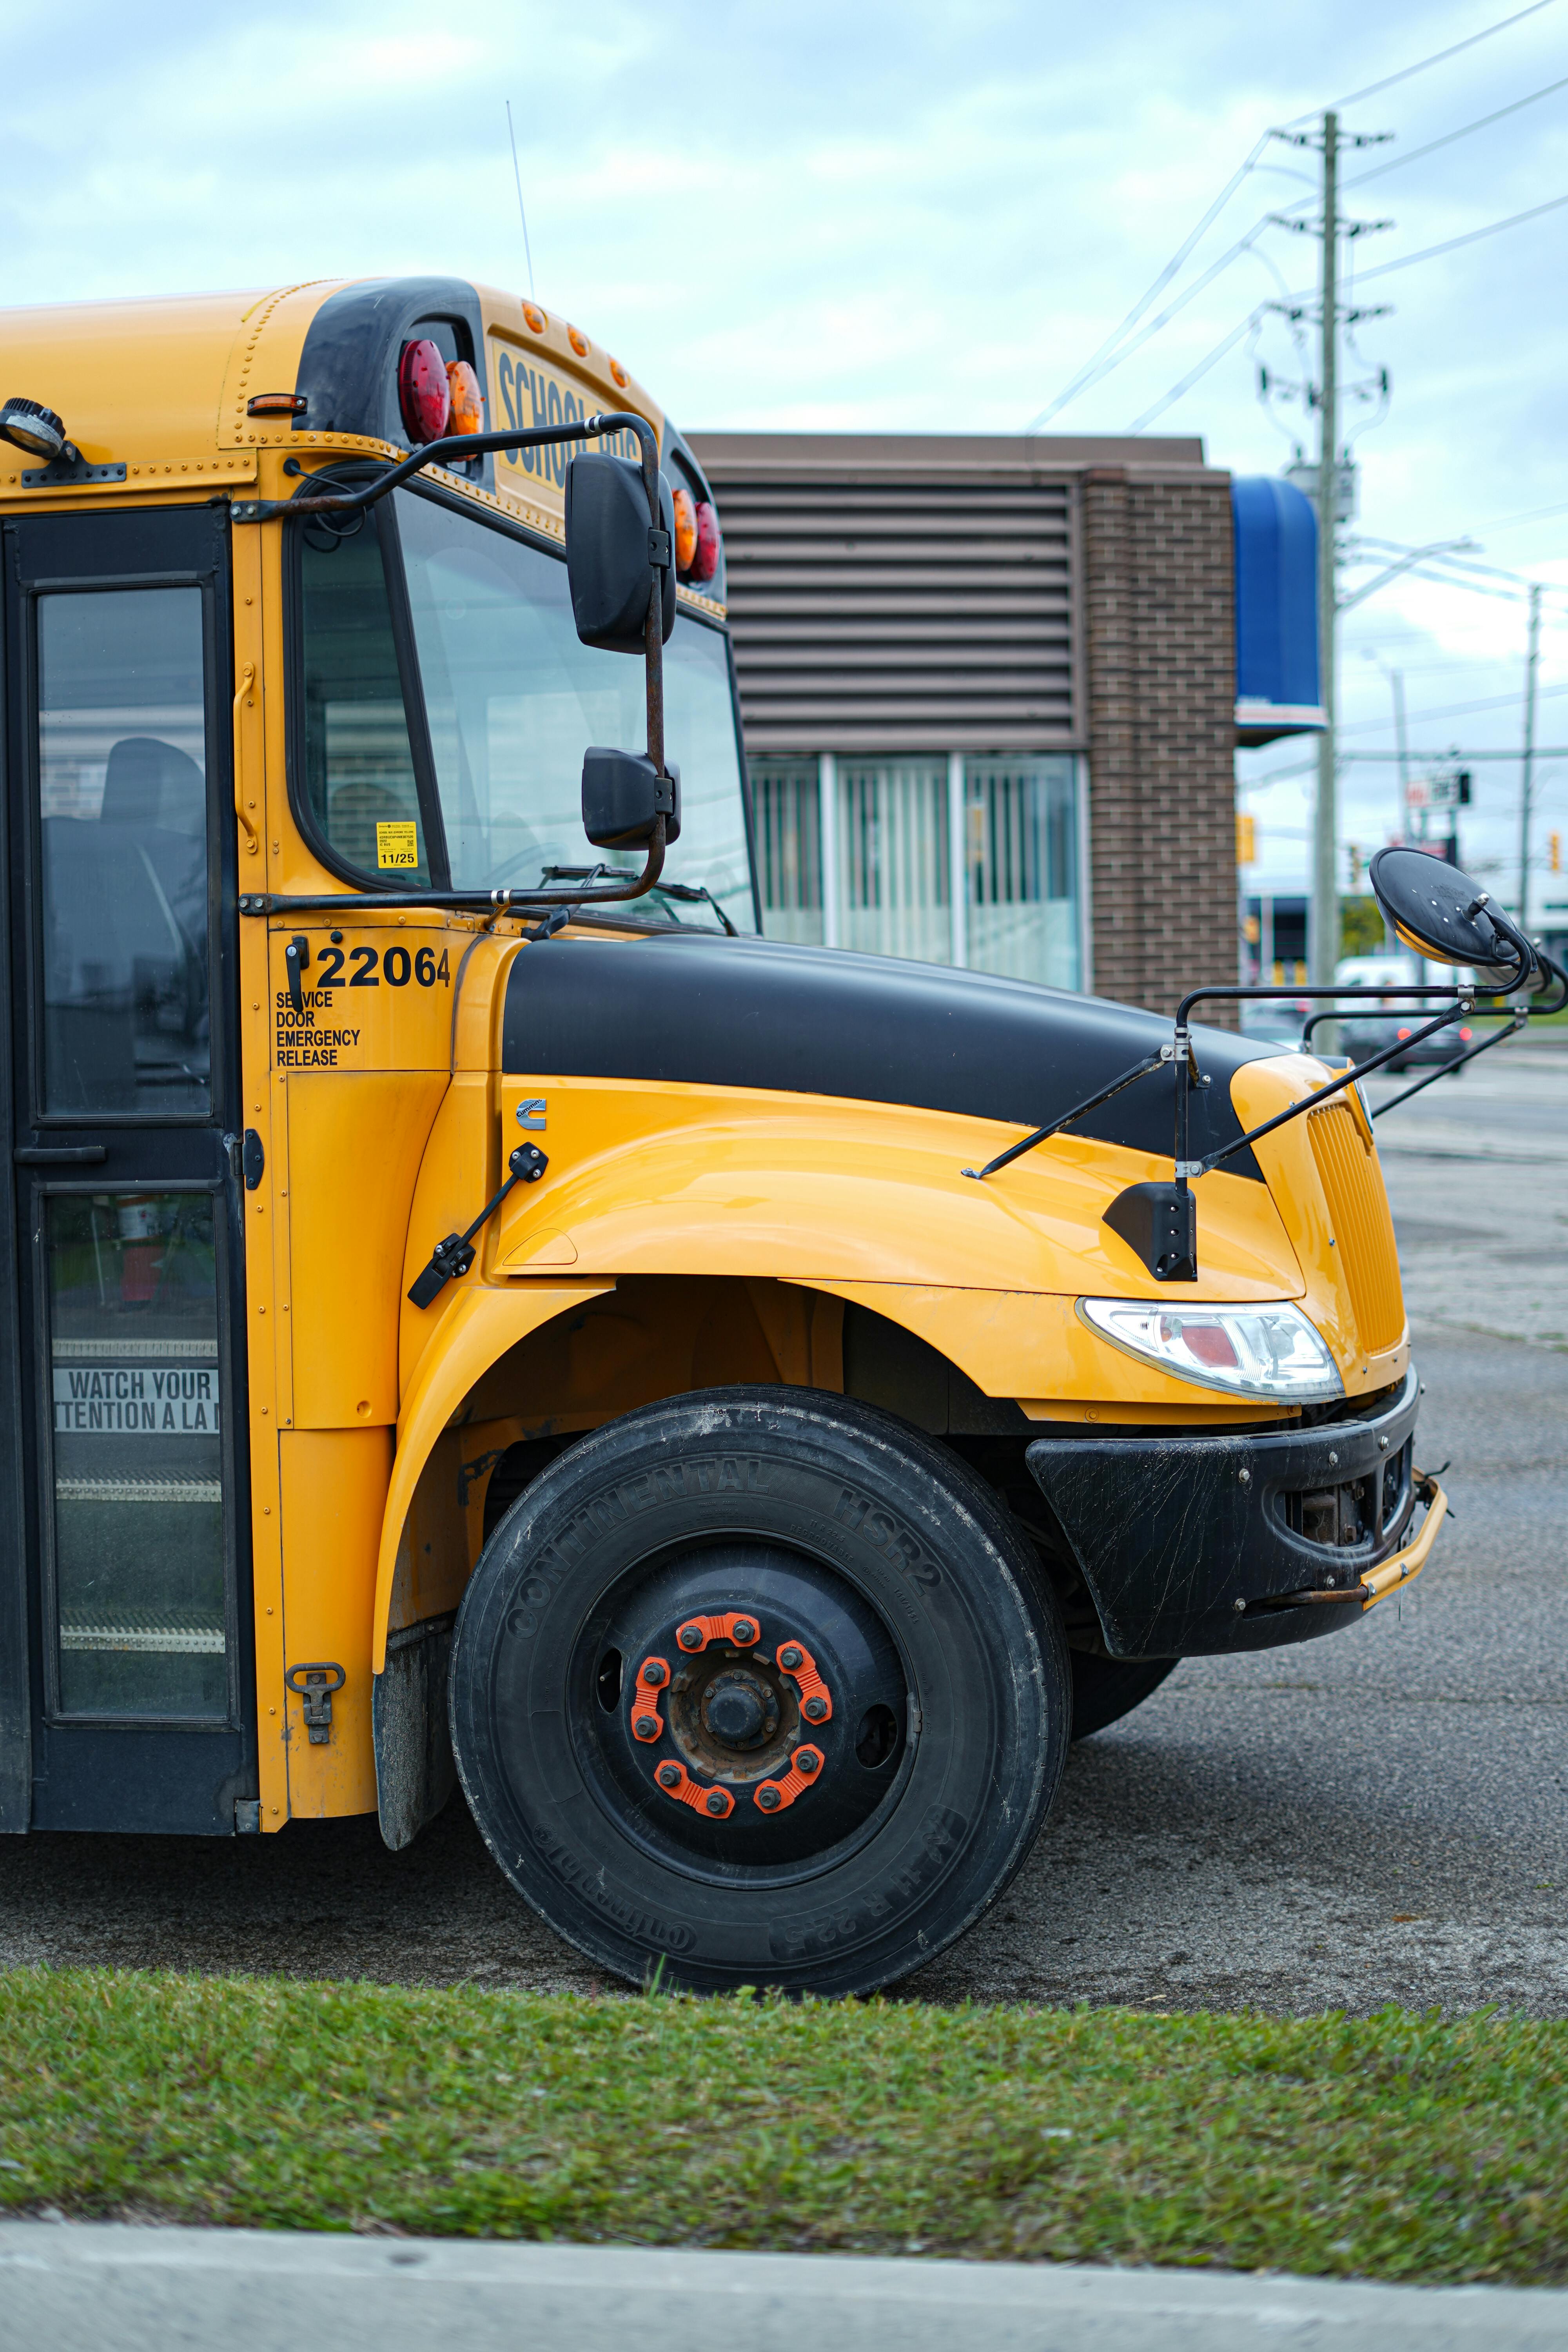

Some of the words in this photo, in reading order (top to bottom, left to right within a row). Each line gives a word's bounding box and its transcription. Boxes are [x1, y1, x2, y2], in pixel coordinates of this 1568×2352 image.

[381, 854, 414, 863] 11/25
[317, 947, 450, 988] 22064
[276, 991, 332, 1008] SEVICE
[277, 1011, 315, 1028] DOOR
[277, 1029, 360, 1047] EMERGENCY
[277, 1049, 338, 1067] RELEASE
[516, 1099, 542, 1117] Cummins
[69, 1371, 144, 1399] WATCH
[152, 1372, 211, 1399] YOUR
[54, 1401, 155, 1430] TTENTION
[162, 1402, 175, 1430] A
[182, 1402, 207, 1430] LA
[789, 1524, 854, 1564] REGROOVABLE
[828, 1528, 846, 1543] 22.5
[508, 1457, 768, 1639] CONTINENTAL
[832, 1489, 942, 1597] HSR2
[548, 1844, 697, 1956] Continental
[785, 1907, 857, 1952] 22.5
